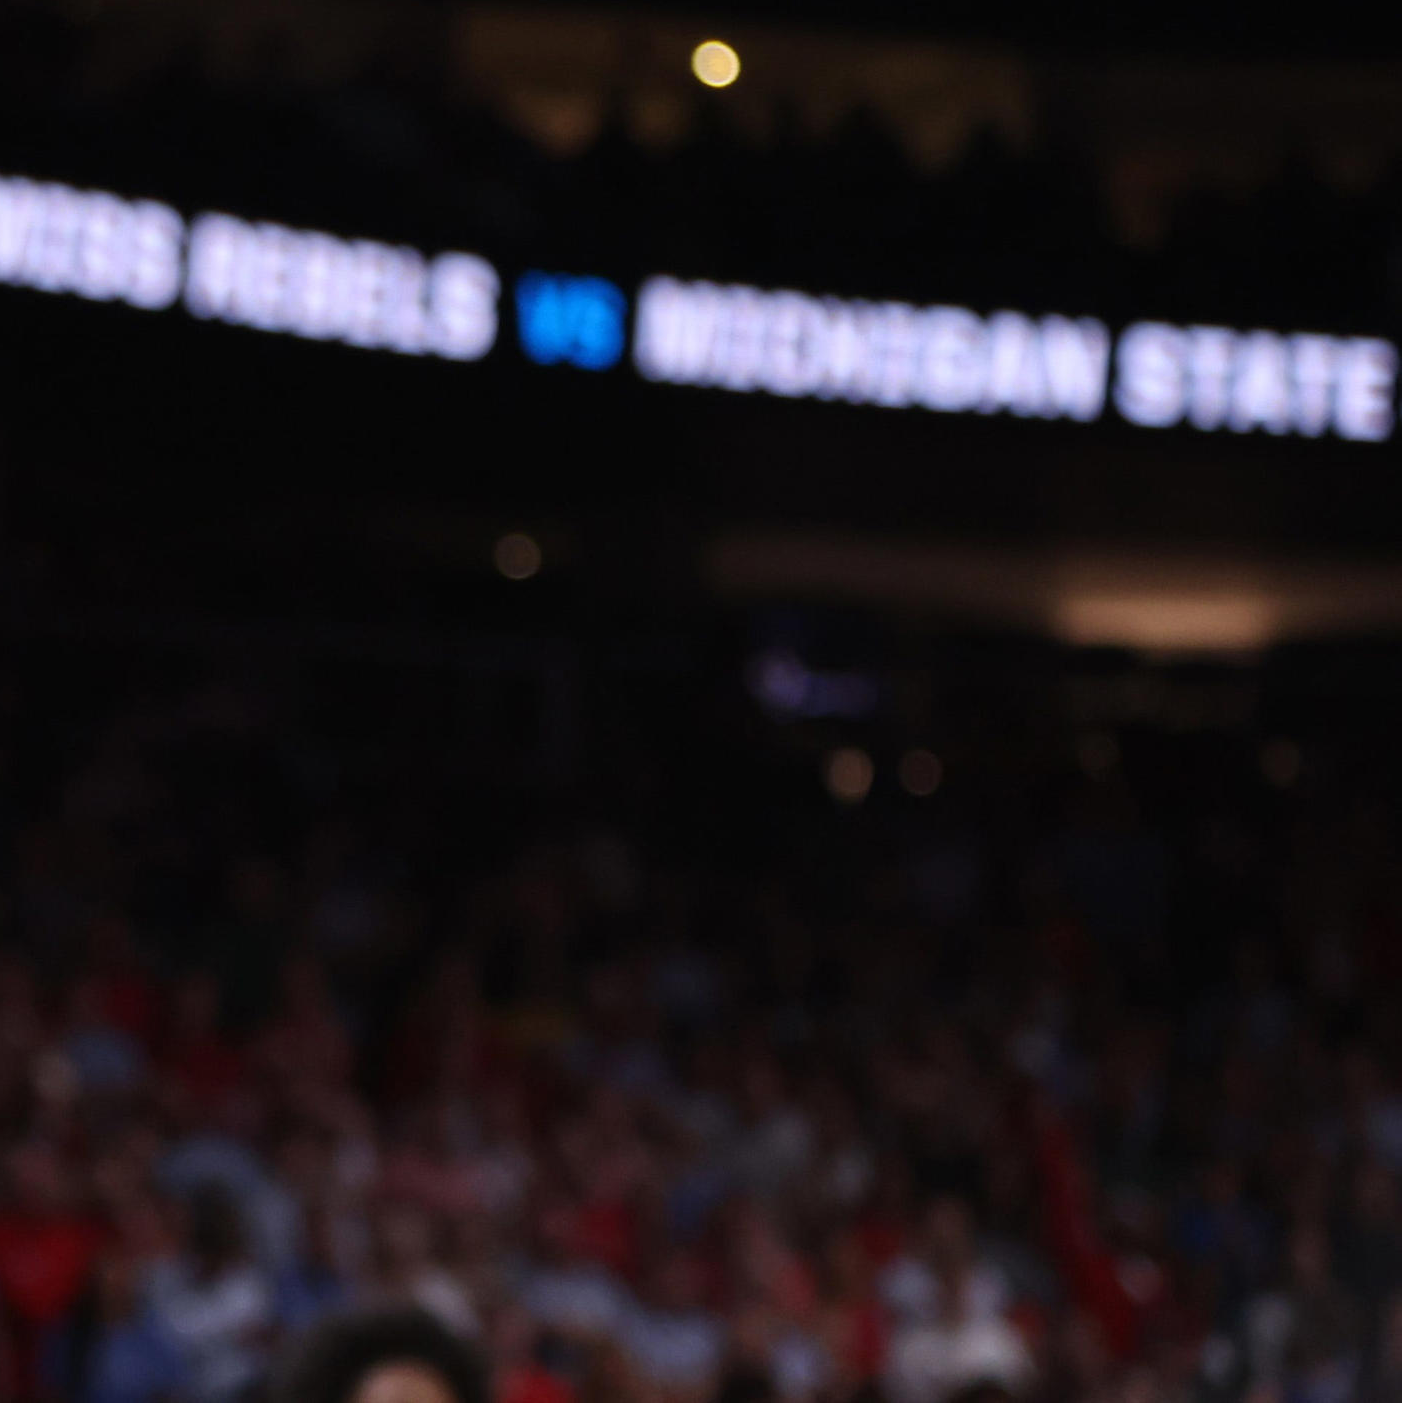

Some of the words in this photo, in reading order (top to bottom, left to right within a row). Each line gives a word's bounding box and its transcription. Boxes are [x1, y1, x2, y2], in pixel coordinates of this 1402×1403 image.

[184, 212, 499, 361] REBELS
[517, 273, 625, 370] VS
[635, 276, 1110, 421] MICHIGAN
[1116, 322, 1395, 442] STATE
